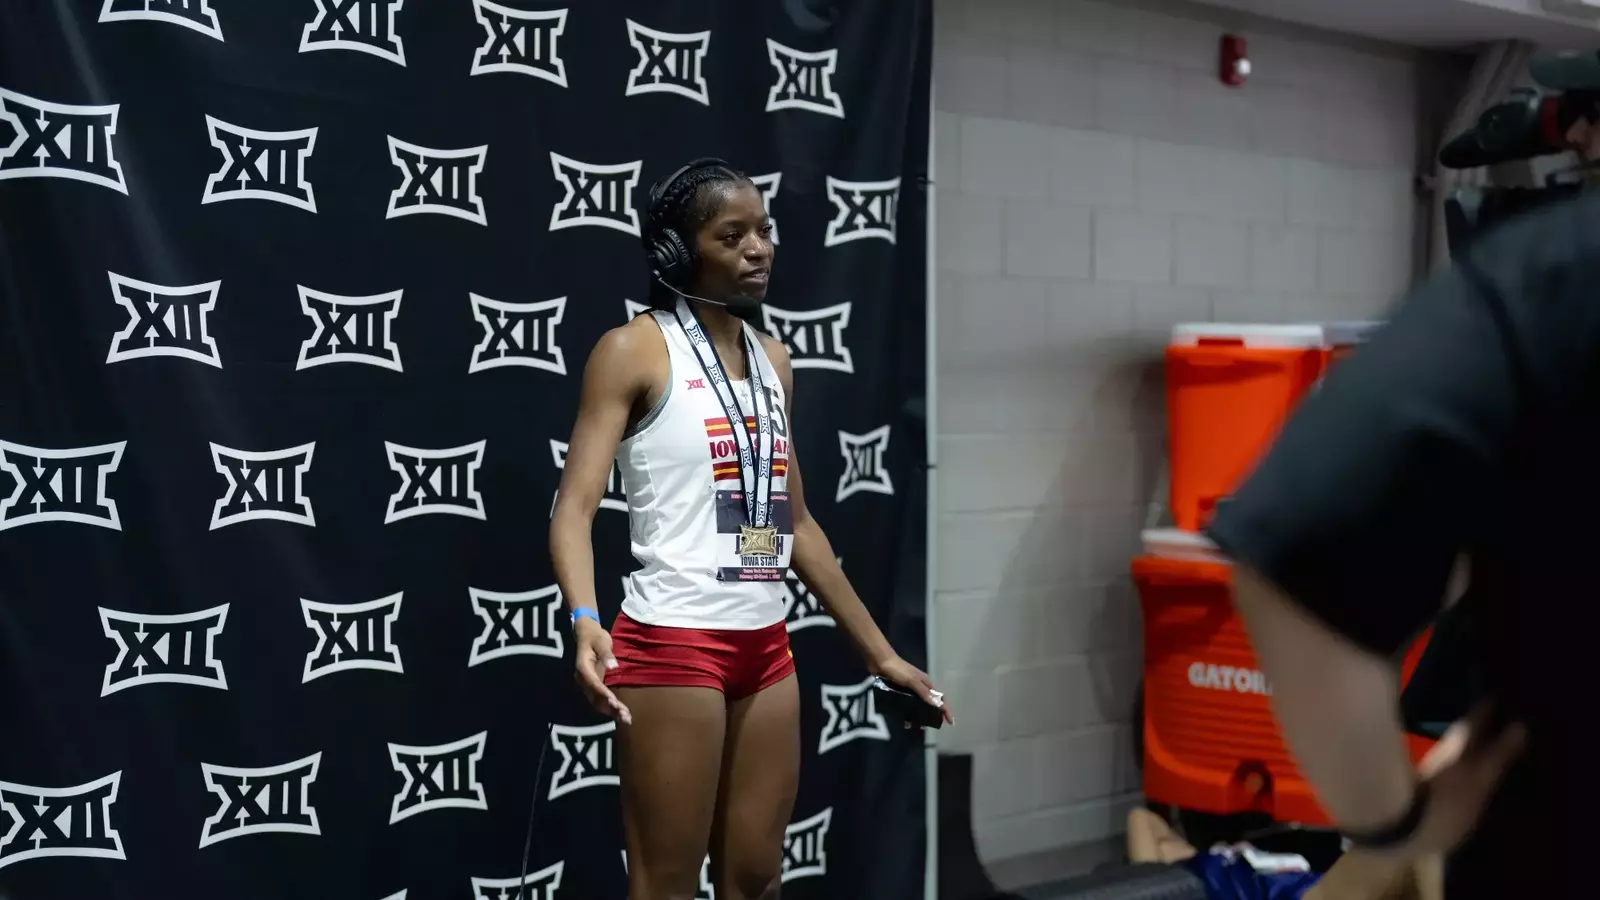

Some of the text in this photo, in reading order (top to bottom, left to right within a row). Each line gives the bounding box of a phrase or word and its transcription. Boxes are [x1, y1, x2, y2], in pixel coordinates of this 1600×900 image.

[474, 0, 564, 83] XII
[629, 23, 707, 101] XII
[769, 43, 841, 113] XII
[0, 92, 124, 190] XII
[206, 119, 313, 208] XII
[390, 140, 484, 221] XII
[553, 156, 638, 233] XII
[828, 180, 897, 242] XII
[111, 276, 217, 364] XII
[300, 288, 399, 368] XII
[473, 296, 562, 371] XII
[765, 305, 850, 369] XII
[685, 378, 706, 390] XII
[0, 445, 122, 526] XII
[213, 446, 312, 526] XII
[388, 444, 482, 520] XII
[839, 430, 891, 497] XII
[741, 556, 779, 566] IOWA STATE
[103, 608, 225, 692] XII
[304, 596, 399, 678] XII
[472, 588, 560, 663] XII
[822, 680, 889, 749] XII
[1188, 662, 1272, 696] GATOR
[204, 757, 317, 844] XII
[392, 736, 483, 819] XII
[0, 775, 121, 863] XII
